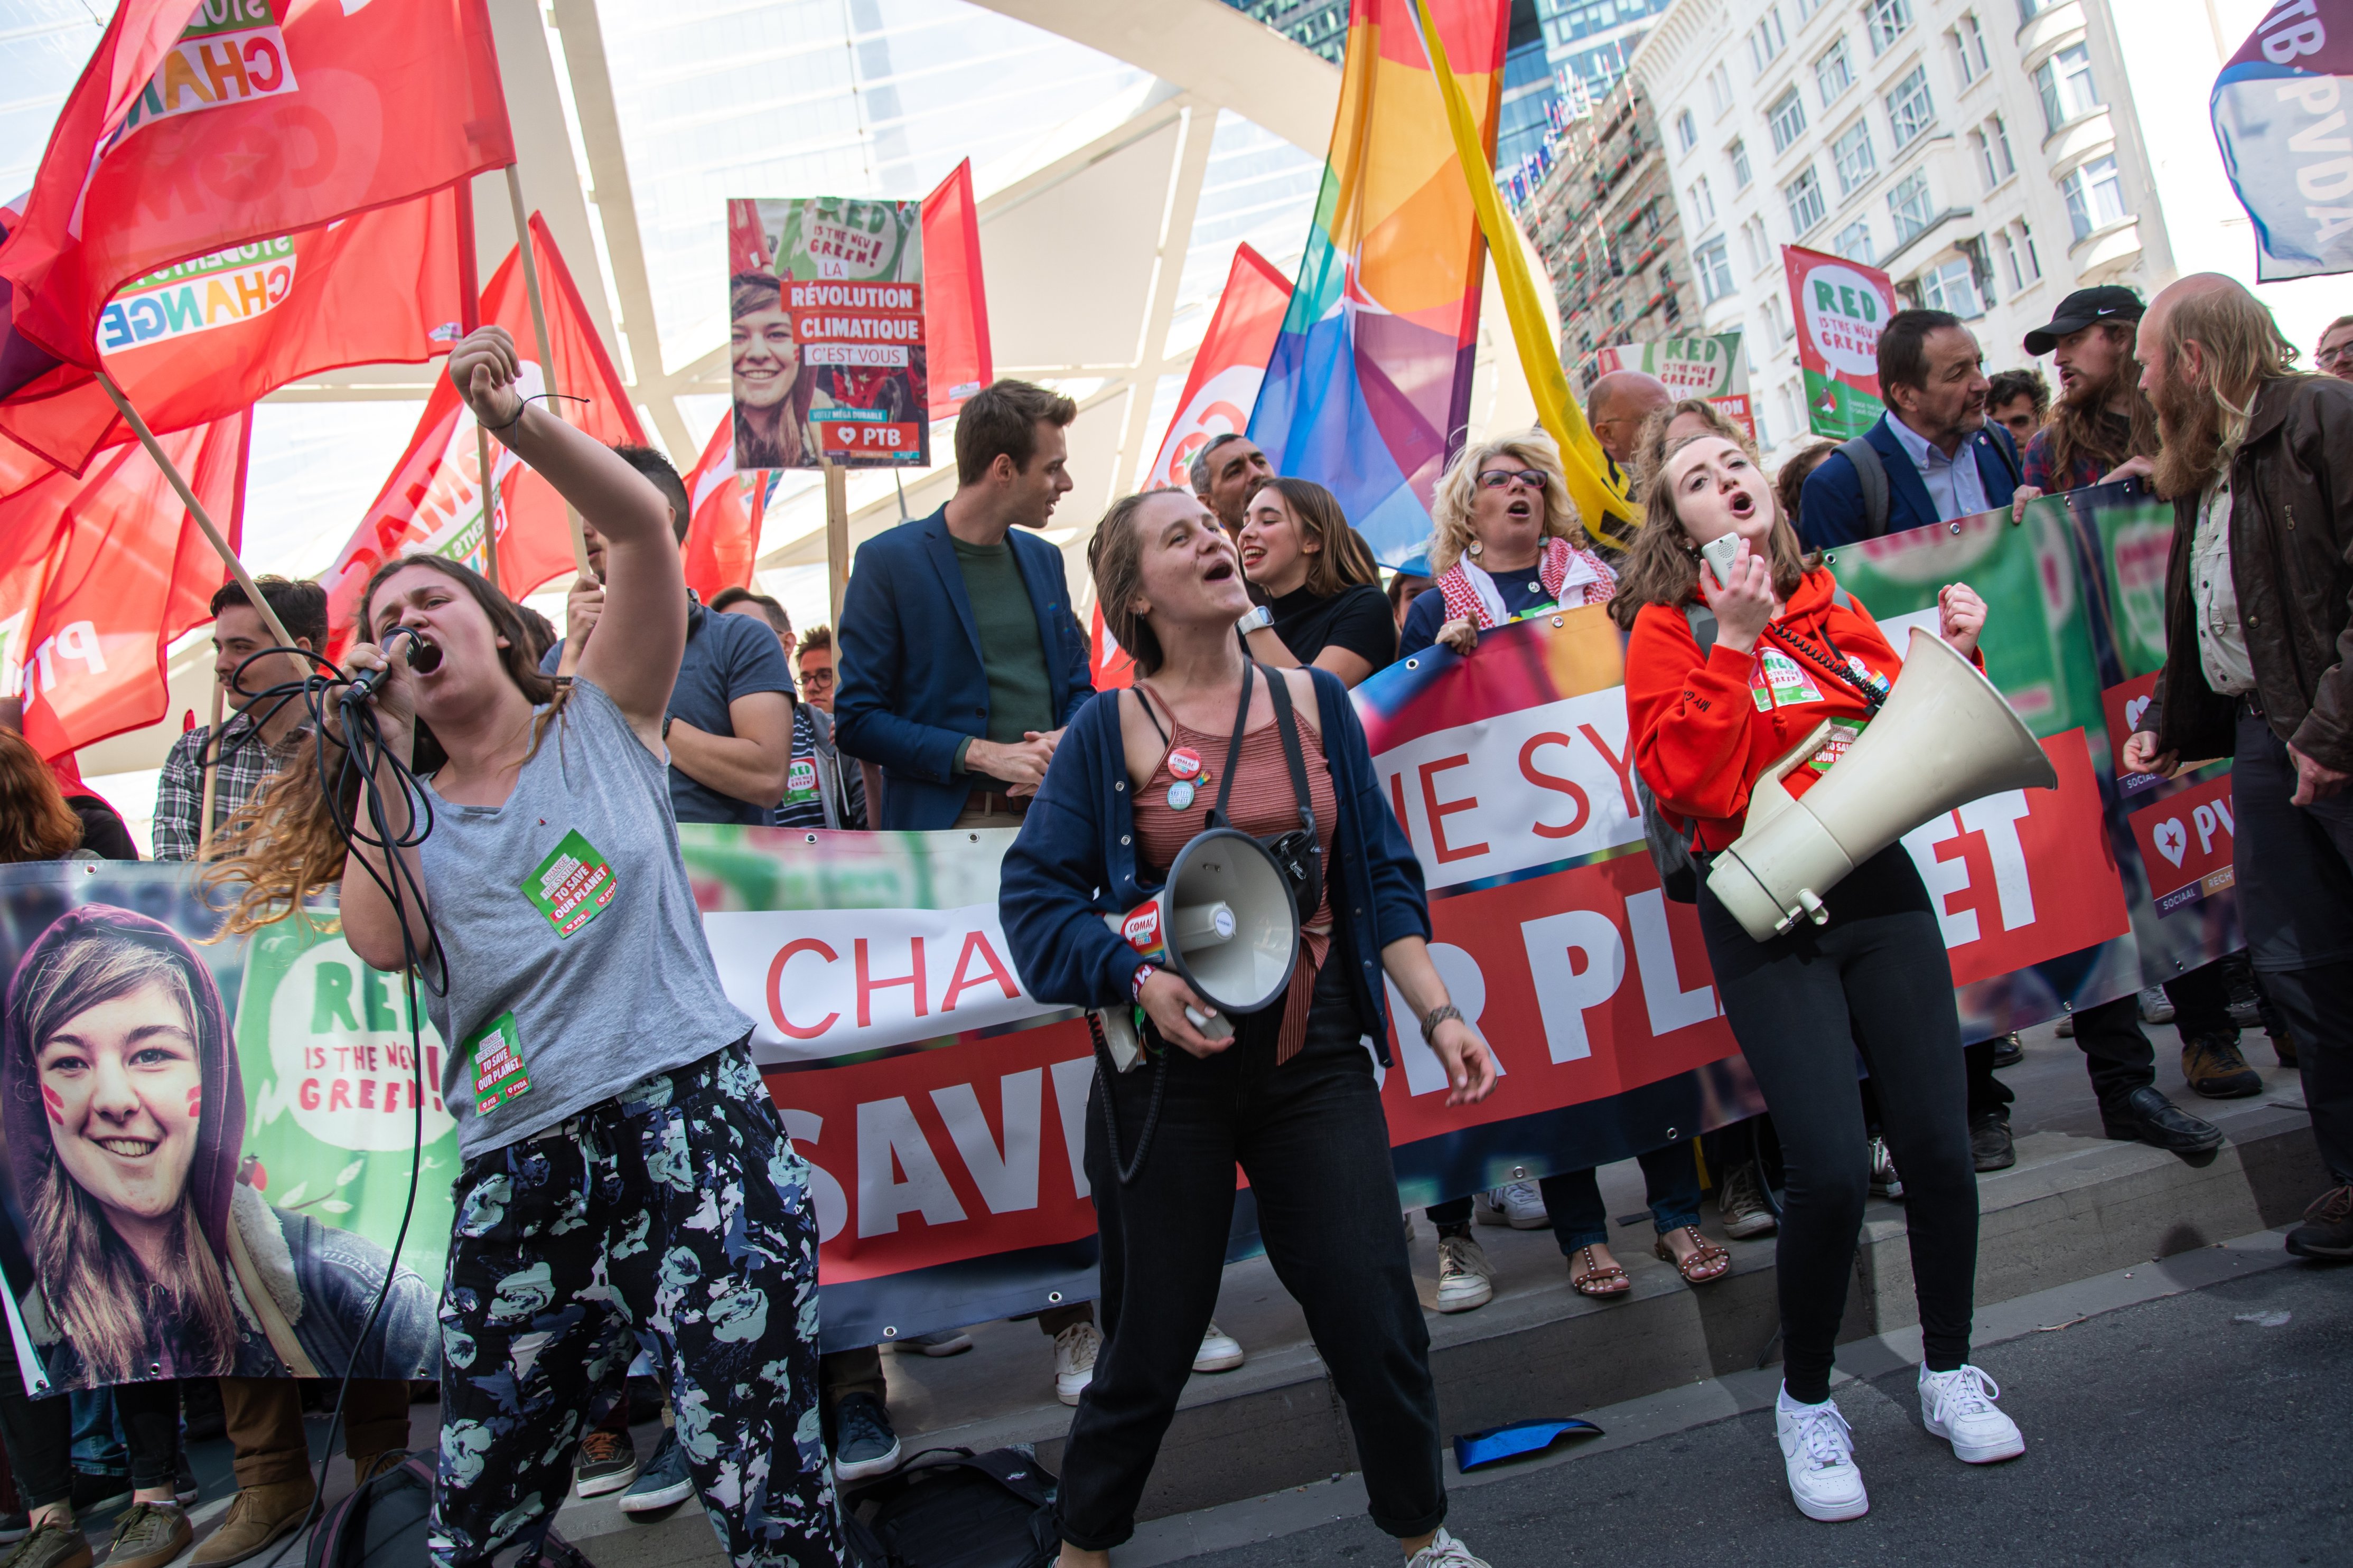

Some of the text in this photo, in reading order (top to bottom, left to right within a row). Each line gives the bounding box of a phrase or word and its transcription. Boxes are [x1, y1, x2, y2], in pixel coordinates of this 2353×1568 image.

[814, 226, 823, 236] IS
[826, 228, 847, 243] THE
[825, 262, 842, 277] LA
[791, 282, 913, 308] RÉVOLUTION
[1813, 279, 1876, 323] RED
[800, 317, 919, 340] CLIMATIQUE
[1818, 316, 1873, 340] IS THE NEW
[858, 349, 900, 364] VOUS
[1665, 338, 1718, 362] RED
[1673, 363, 1688, 373] THE
[853, 410, 883, 420] DURABLE
[863, 427, 901, 447] PTB
[1832, 726, 1854, 735] HANGE
[1836, 743, 1852, 752] SAV
[544, 857, 568, 883] CHANGE
[544, 861, 577, 897] THE SYSTEM
[555, 865, 590, 901] TO SAVE
[555, 867, 607, 919] OUR PLANET
[2163, 886, 2196, 910] SOCIAAL
[574, 914, 586, 925] PTB
[1130, 917, 1153, 933] COMAC
[767, 932, 1020, 1039] CHA
[477, 1039, 504, 1062] THE SYSTEM
[481, 1031, 500, 1048] CHANGE
[305, 1046, 326, 1070] IS
[333, 1045, 378, 1072] THE
[482, 1048, 508, 1073] TO SAVE
[478, 1057, 520, 1091] OUR PLANET
[513, 1080, 527, 1092] PVDA
[488, 1097, 497, 1106] PTB
